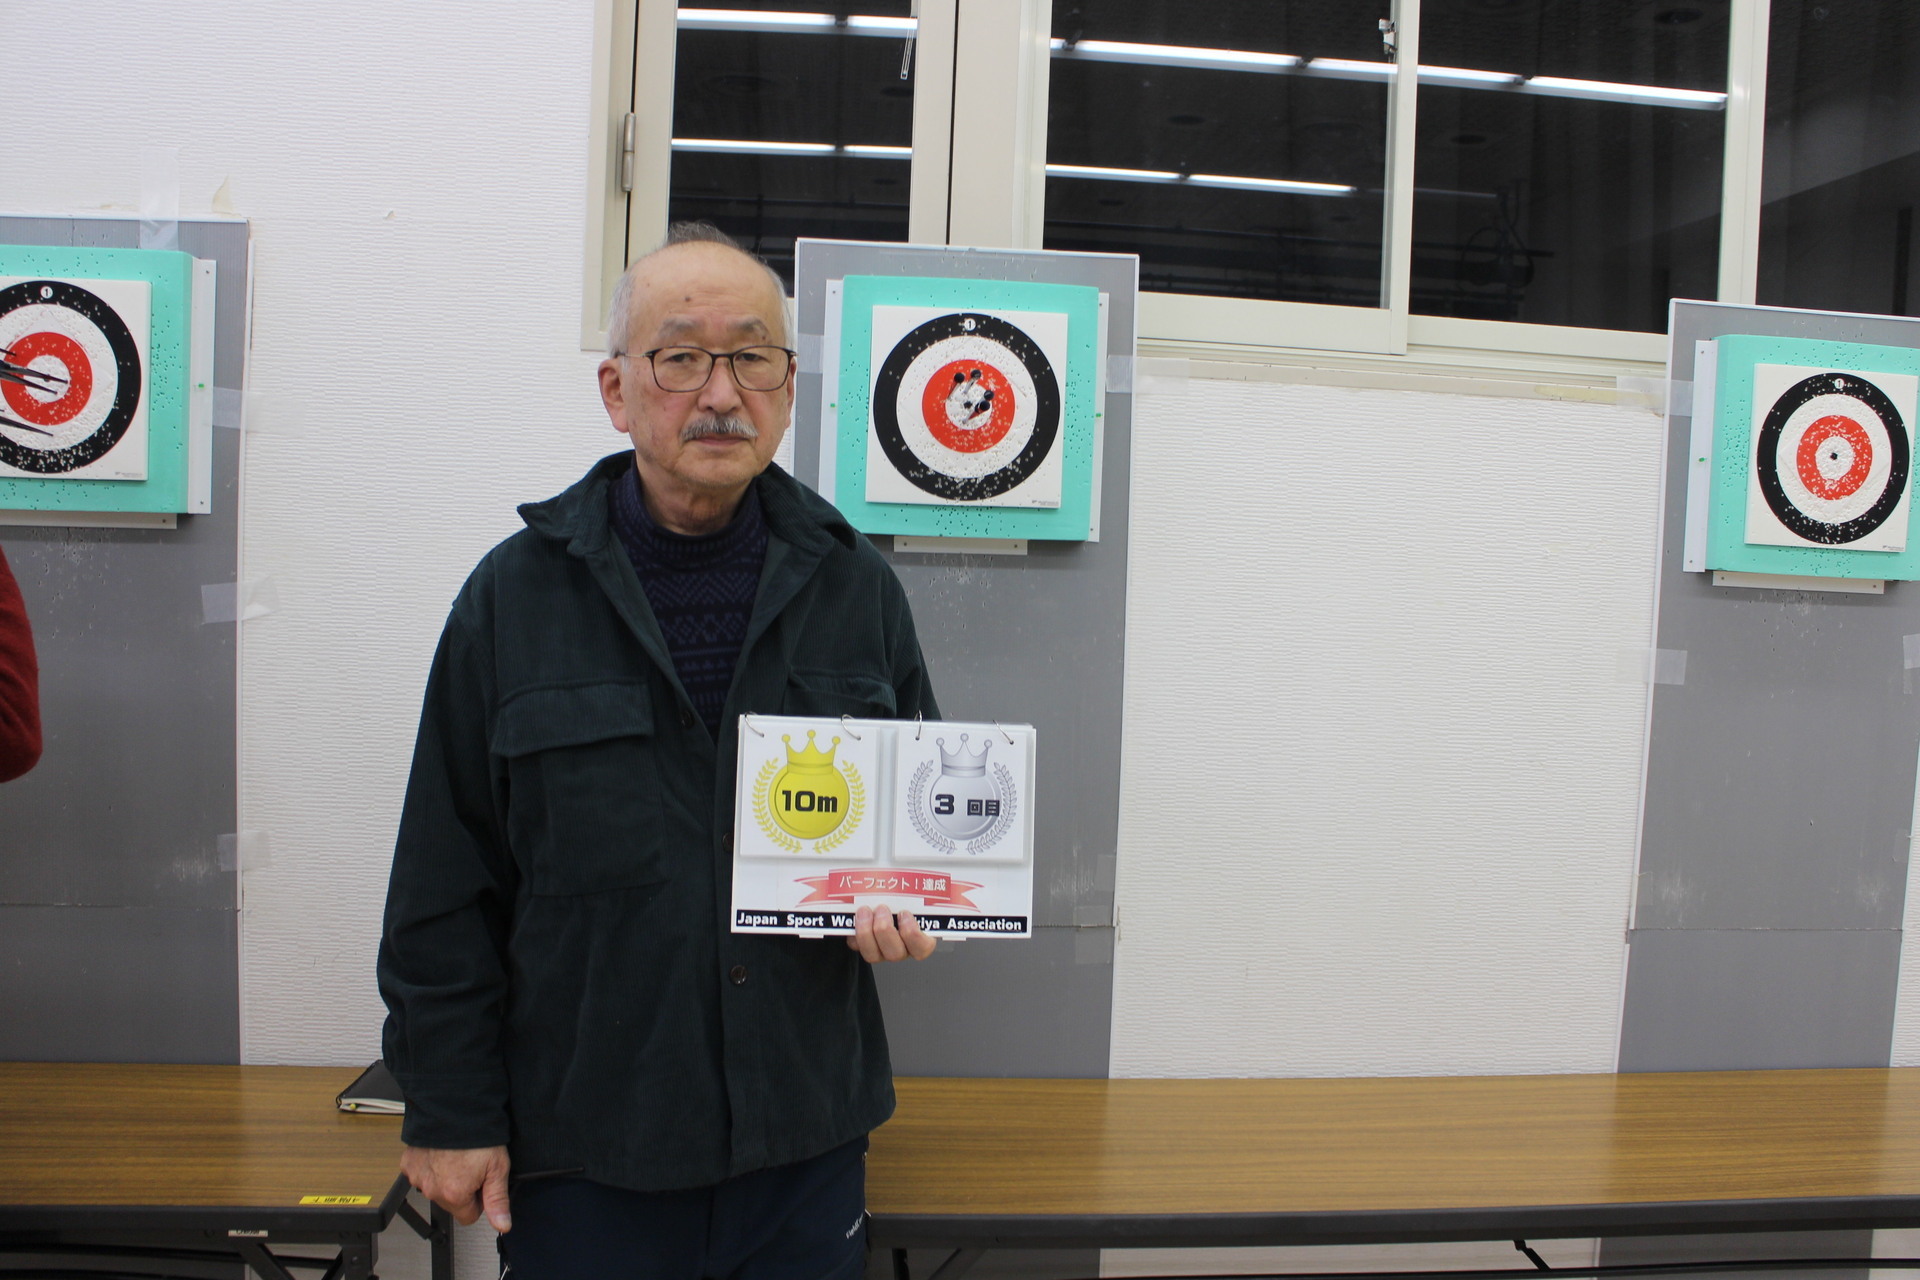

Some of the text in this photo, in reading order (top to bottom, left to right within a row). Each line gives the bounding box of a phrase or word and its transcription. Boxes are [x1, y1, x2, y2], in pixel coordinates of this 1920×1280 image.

[782, 790, 838, 813] 10m
[934, 793, 1000, 817] 3 回目
[737, 912, 778, 927] Japan
[787, 914, 824, 928] Sport
[947, 917, 1022, 931] Association
